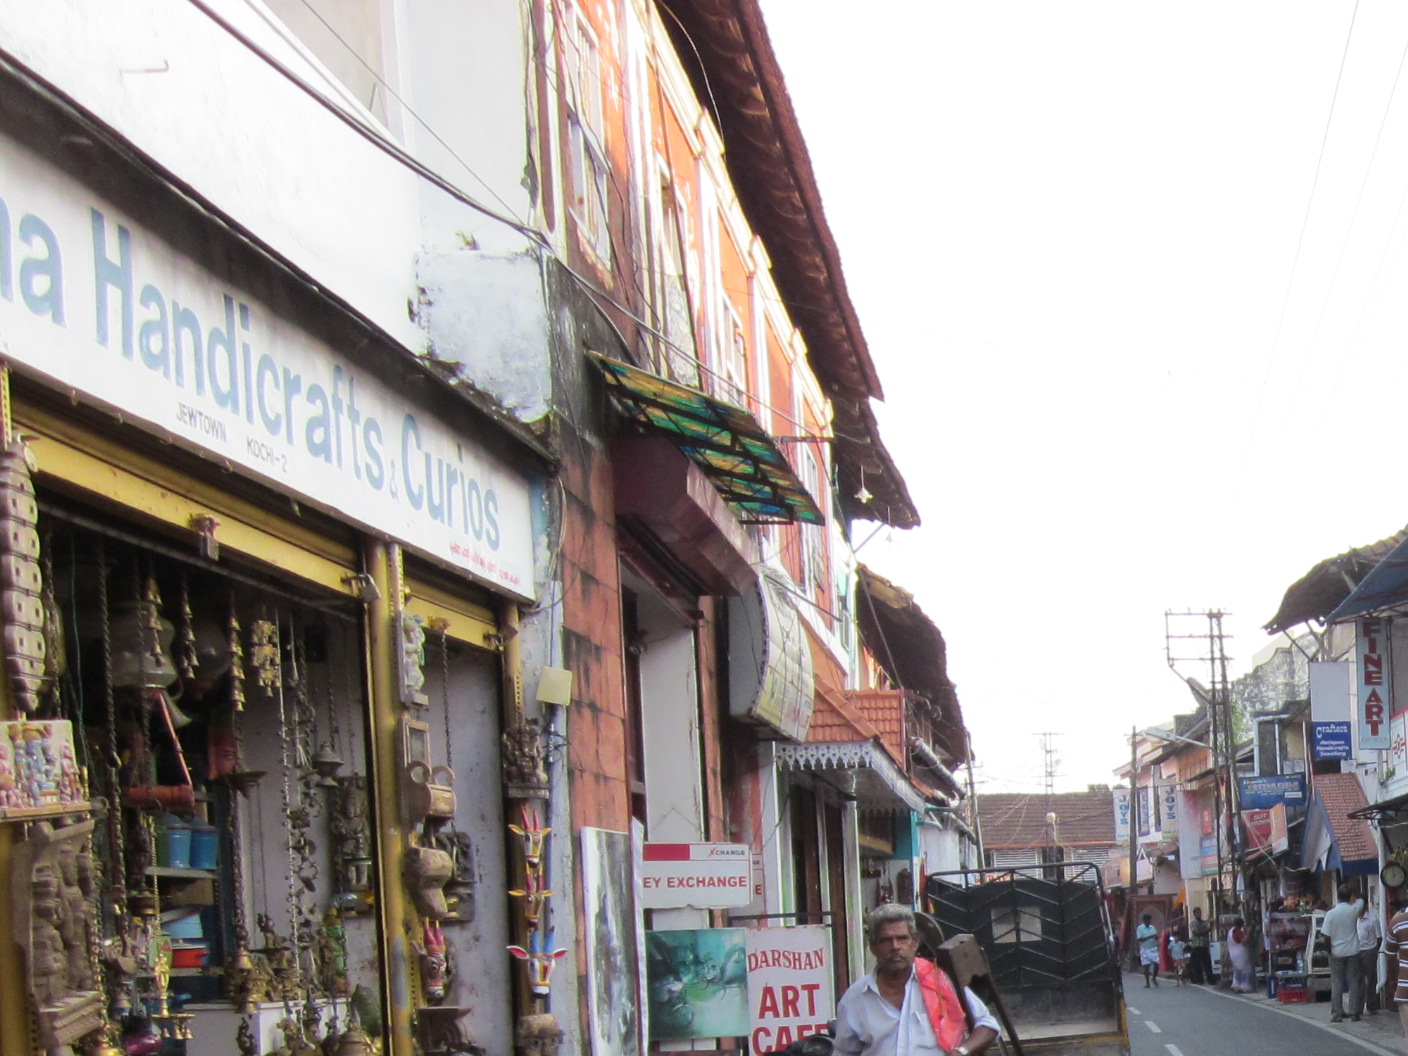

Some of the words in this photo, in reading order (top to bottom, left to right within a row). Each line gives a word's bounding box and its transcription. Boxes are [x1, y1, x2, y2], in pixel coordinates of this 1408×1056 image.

[90, 206, 385, 492] Handicrafts
[389, 458, 400, 501] &
[401, 414, 501, 551] Curios
[176, 400, 227, 443] JEWTOWN
[246, 436, 288, 473] KOCHI-2
[1363, 621, 1383, 686] FINE
[1365, 687, 1384, 736] ART
[1119, 794, 1129, 826] JOYS
[1165, 787, 1177, 820] JOYS
[708, 845, 745, 857] XCHANGE
[667, 876, 747, 888] EXCHANGE
[747, 948, 824, 973] DARSHAN
[758, 984, 820, 1019] ART
